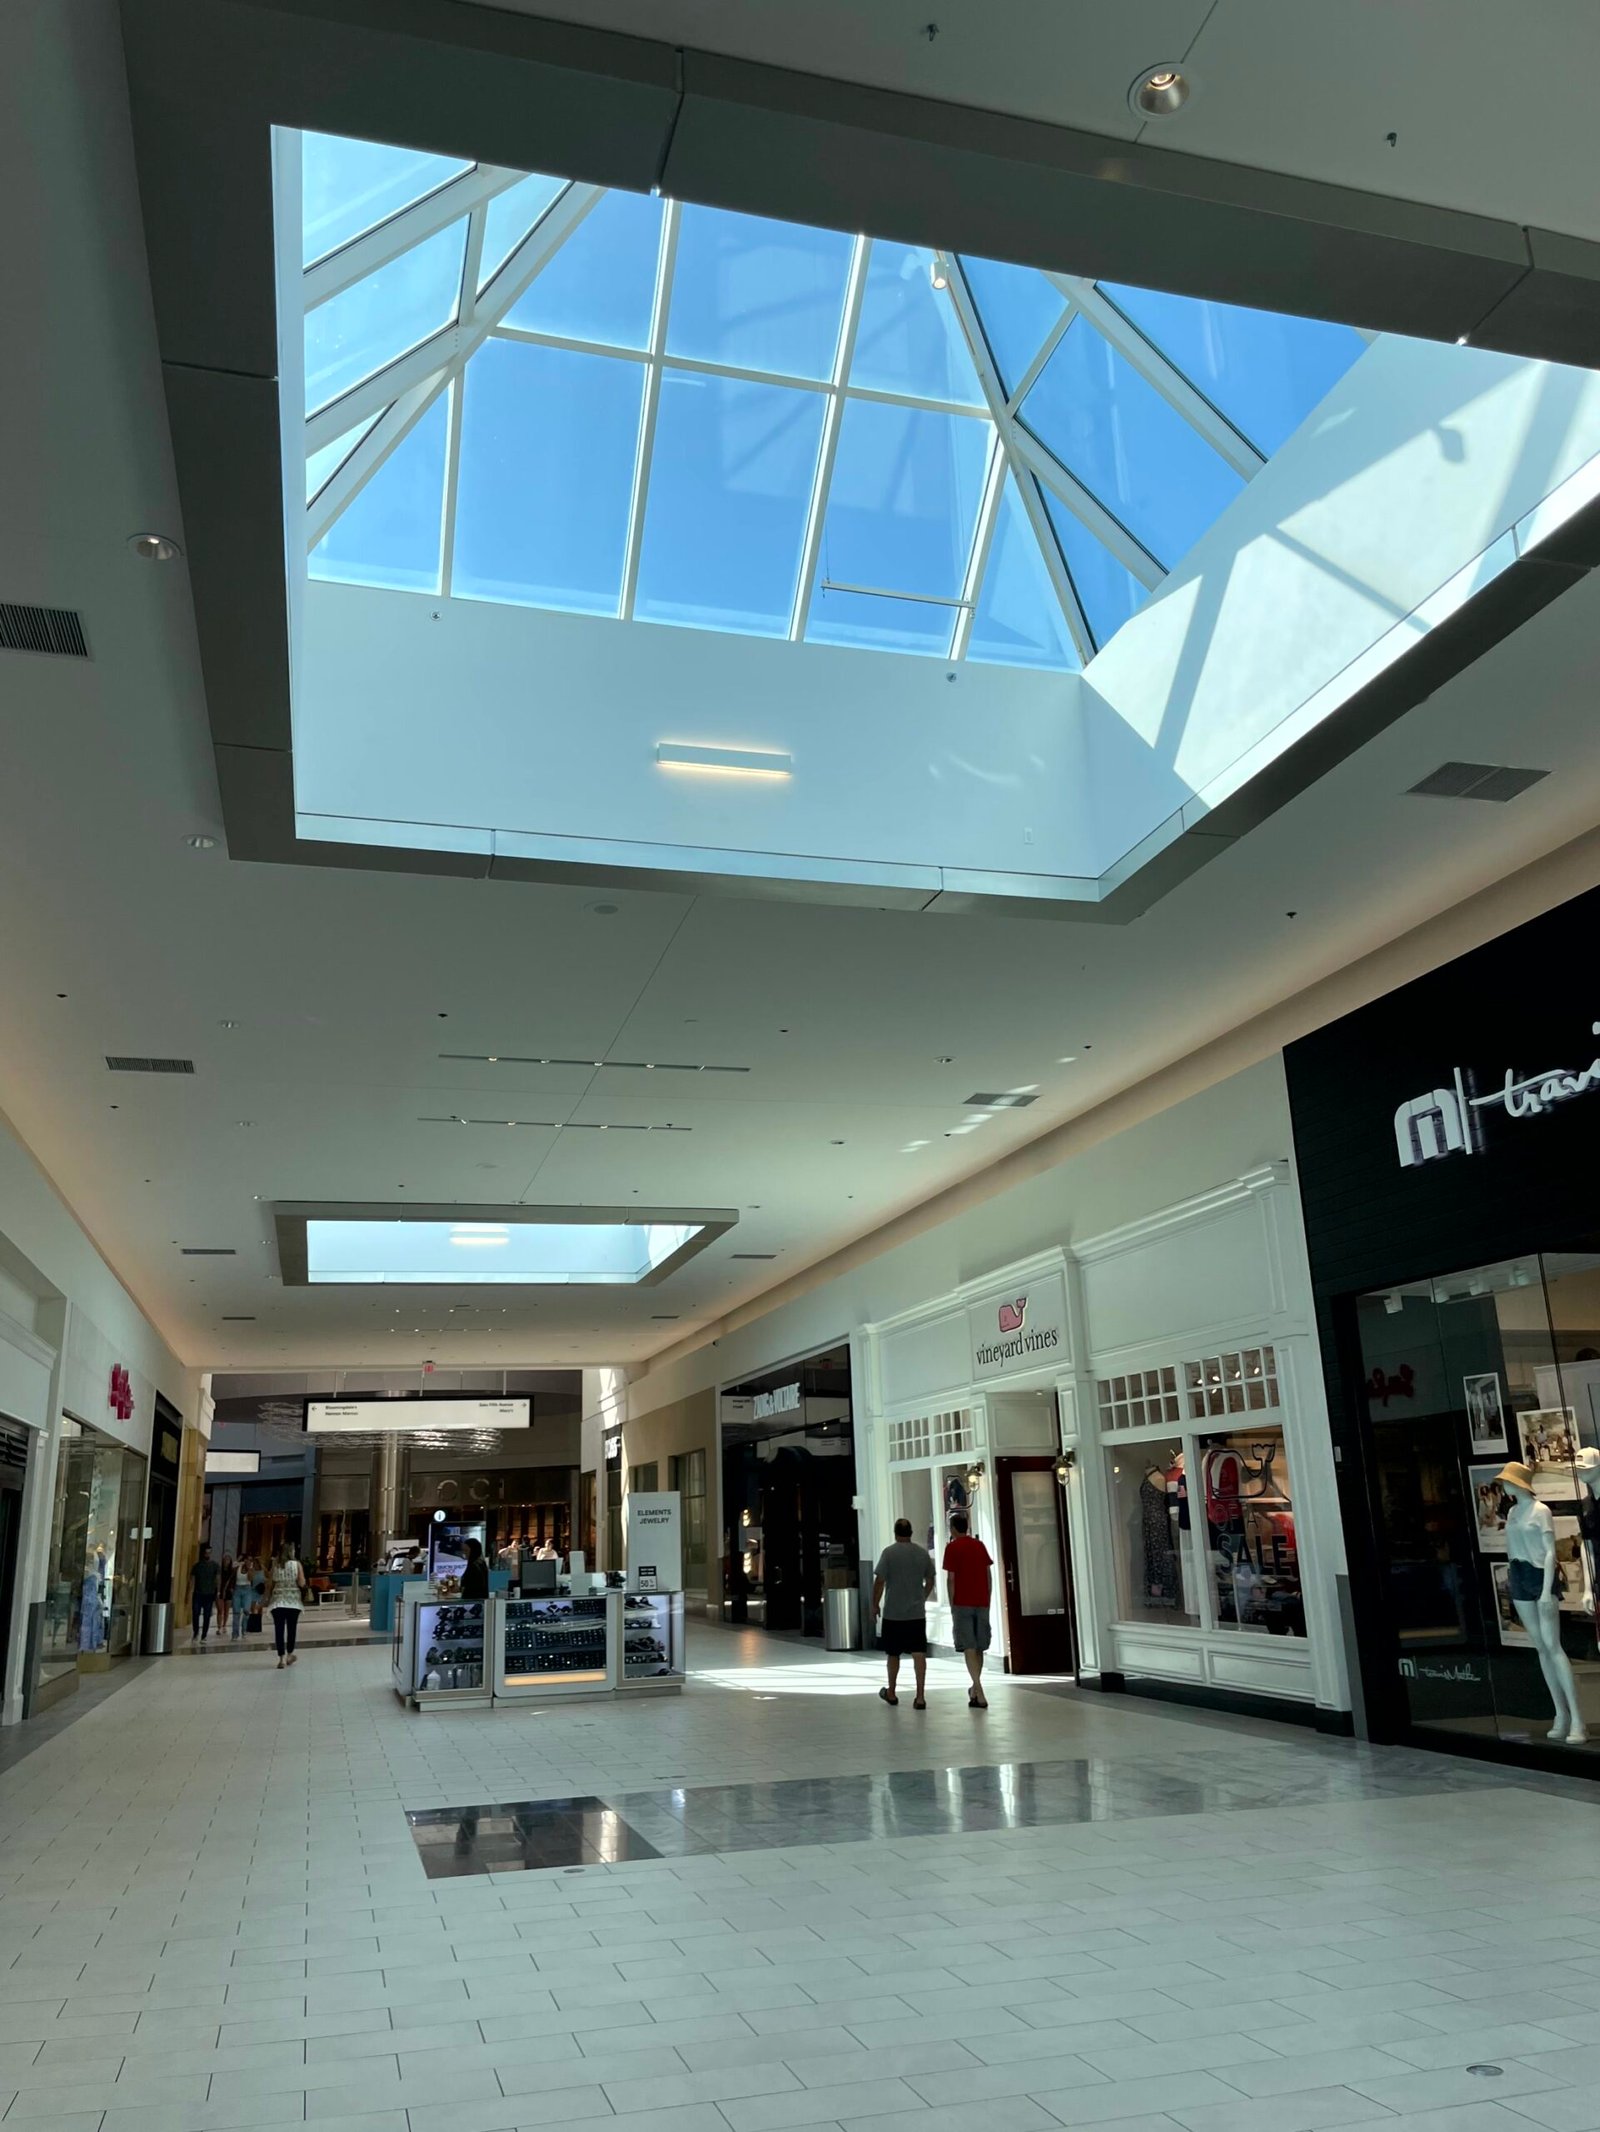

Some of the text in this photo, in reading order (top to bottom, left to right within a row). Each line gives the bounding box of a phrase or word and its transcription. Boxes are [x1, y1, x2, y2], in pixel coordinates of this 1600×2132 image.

[976, 1328, 1059, 1368] vineyard vines
[637, 1508, 672, 1517] ELEMENTS
[639, 1517, 670, 1525] JEWELRY
[1216, 1531, 1292, 1576] SALE
[640, 1579, 649, 1588] 50
